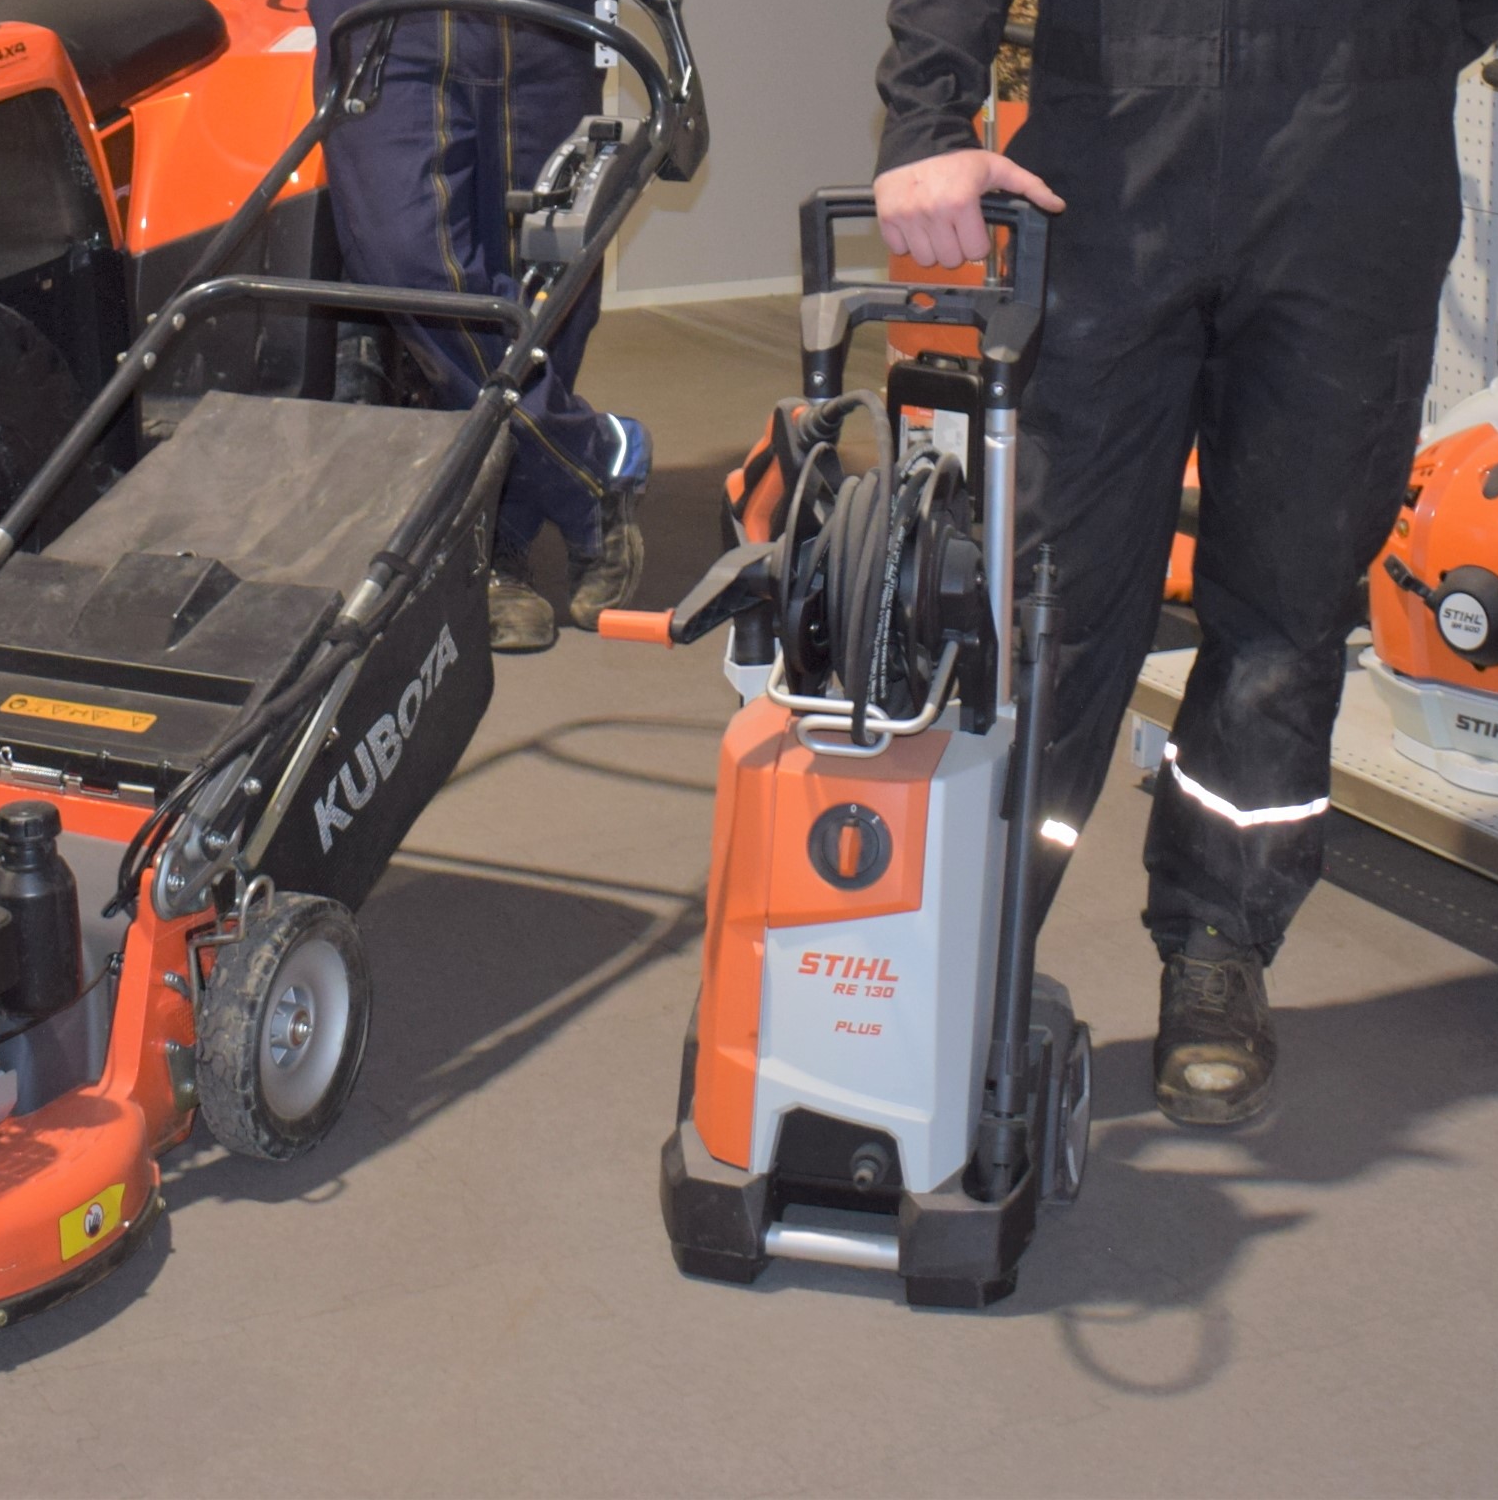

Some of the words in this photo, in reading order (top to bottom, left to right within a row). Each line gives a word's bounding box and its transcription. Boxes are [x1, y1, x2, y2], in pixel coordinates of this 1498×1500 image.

[1443, 607, 1483, 626] STIHL
[314, 623, 459, 855] KUBOTA
[798, 951, 899, 982] STIHL
[833, 982, 858, 996] RE
[864, 985, 896, 999] 130
[834, 1020, 883, 1036] PLUS
